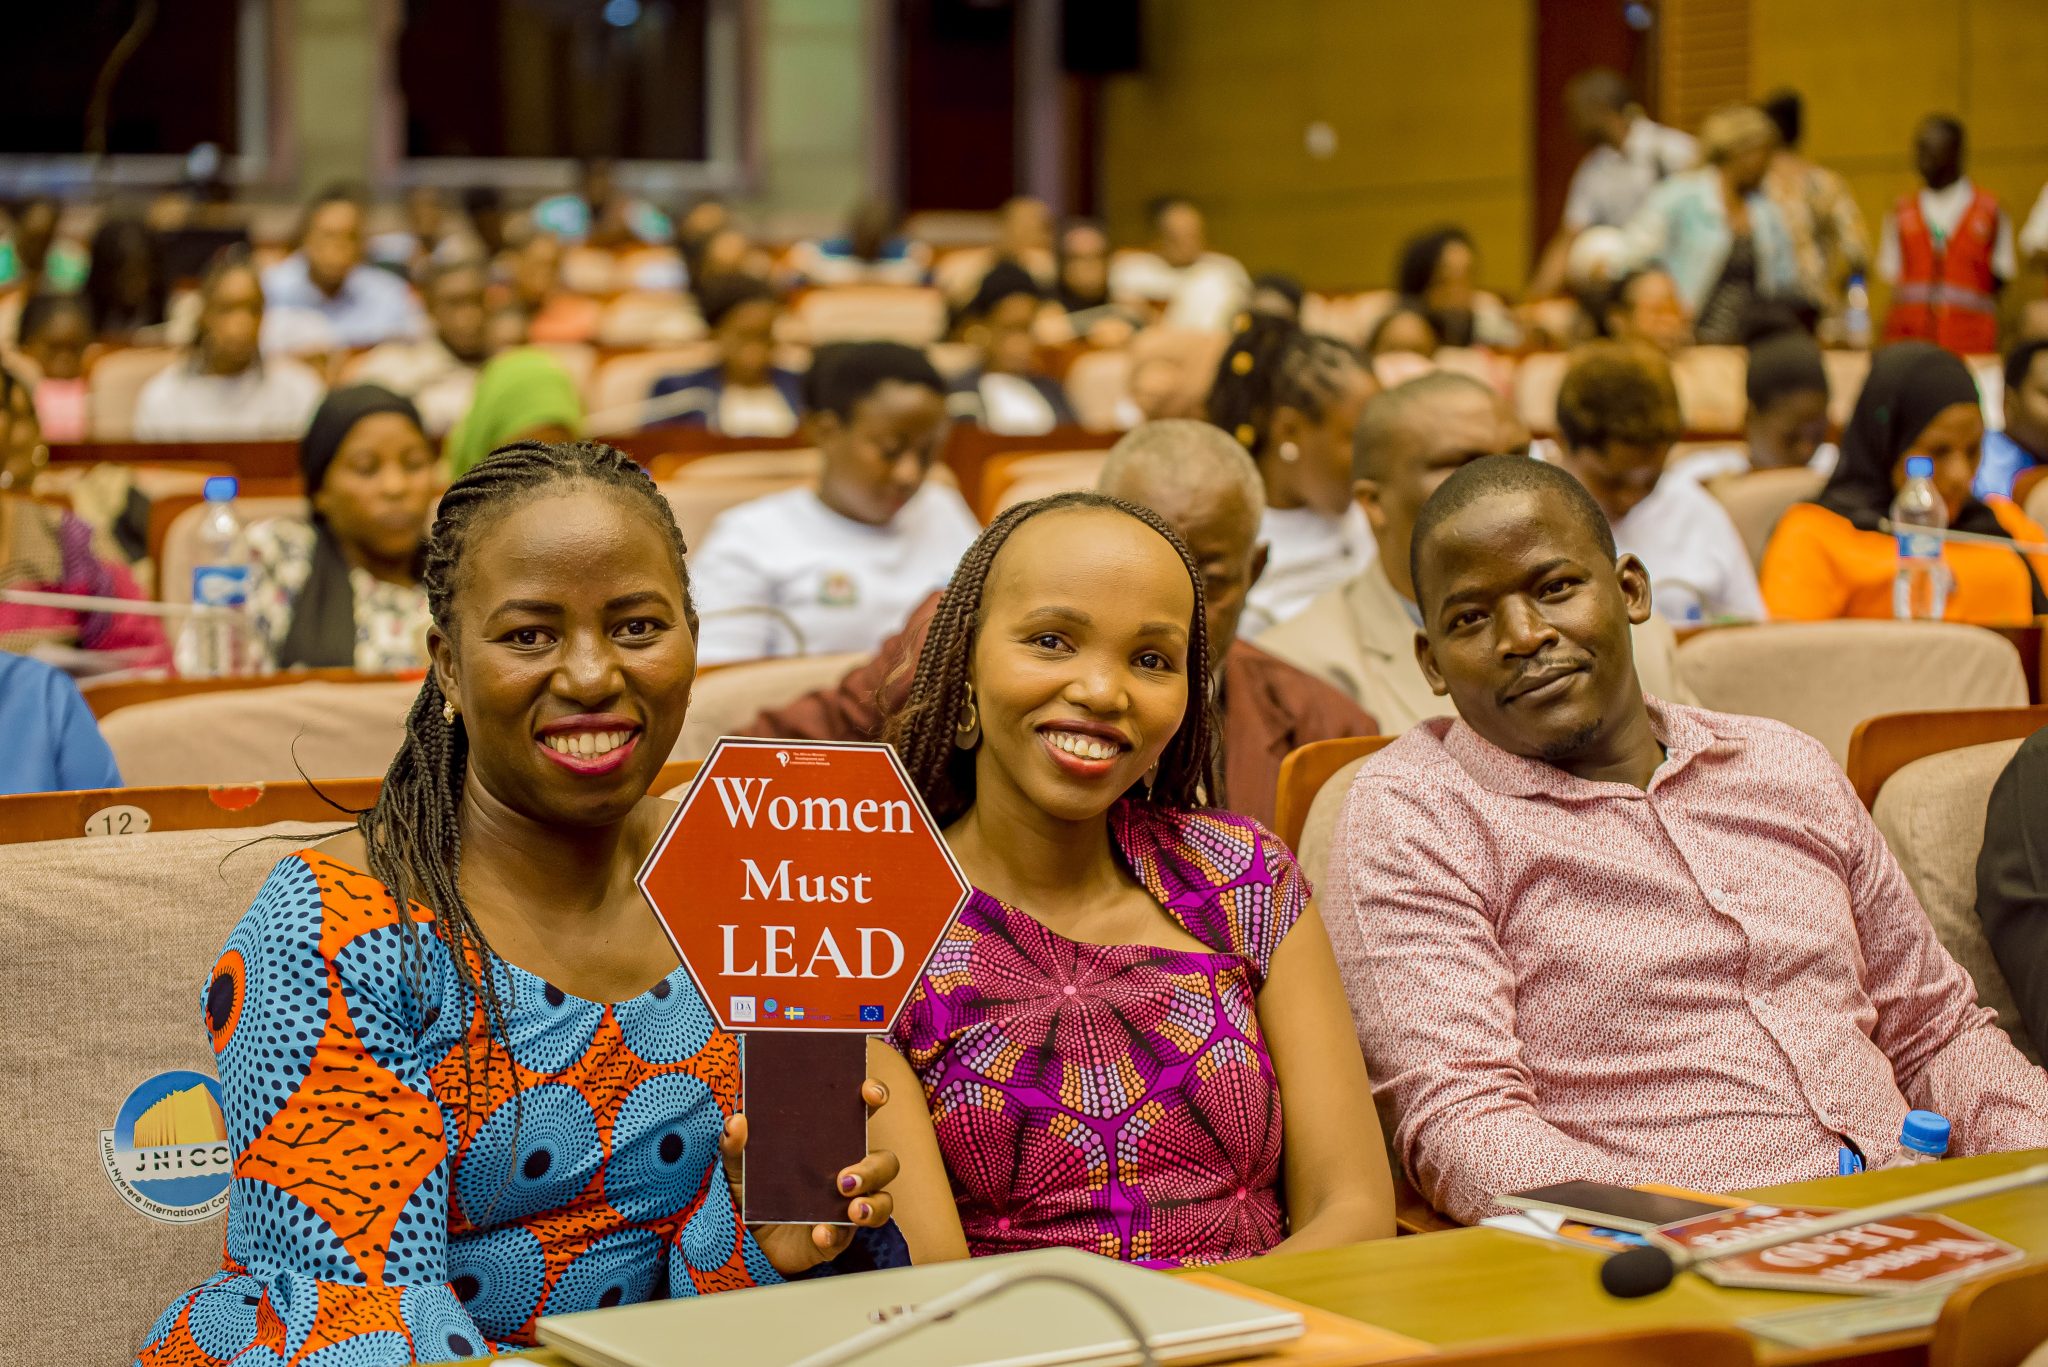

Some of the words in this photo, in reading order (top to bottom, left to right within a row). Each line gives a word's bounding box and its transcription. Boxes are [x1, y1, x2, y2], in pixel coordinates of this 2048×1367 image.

[102, 812, 133, 835] 12
[710, 776, 914, 834] Women
[740, 858, 872, 904] Must
[718, 924, 905, 979] LEAD
[104, 1136, 116, 1167] Julius
[112, 1167, 142, 1203] Nyerere
[143, 1199, 210, 1217] International
[212, 1193, 229, 1208] Con
